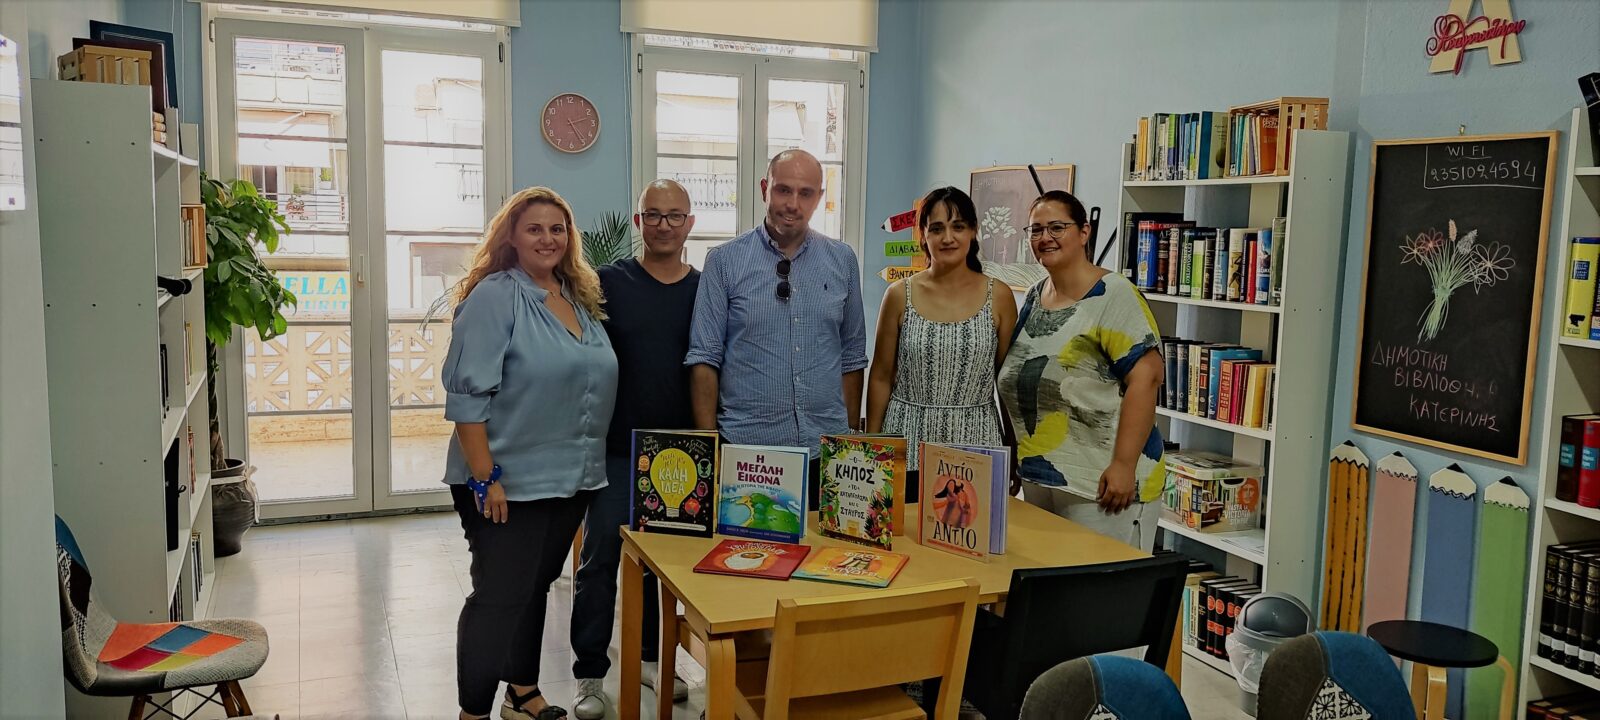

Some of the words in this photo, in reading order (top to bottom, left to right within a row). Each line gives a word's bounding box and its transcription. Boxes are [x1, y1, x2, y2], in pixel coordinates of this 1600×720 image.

[1446, 145, 1465, 157] WI
[1472, 145, 1486, 157] FI
[1430, 159, 1537, 182] 2351024594
[1371, 340, 1448, 372] ΔΗΜΟΤΙΚΗ
[1409, 393, 1501, 432] ΚΑΤΕΡΙΝΗΣ
[756, 454, 765, 464] Η
[658, 467, 688, 482] ΚΑΛΗ
[736, 461, 784, 476] ΜΕΓΑΛΗ
[835, 463, 875, 485] ΚΗΠΟΣ
[737, 471, 781, 486] ΕΙΚΟΝΑ
[661, 481, 686, 495] ΙΔΕΑ
[840, 506, 865, 520] ΣΤΑΥΡΟΣ
